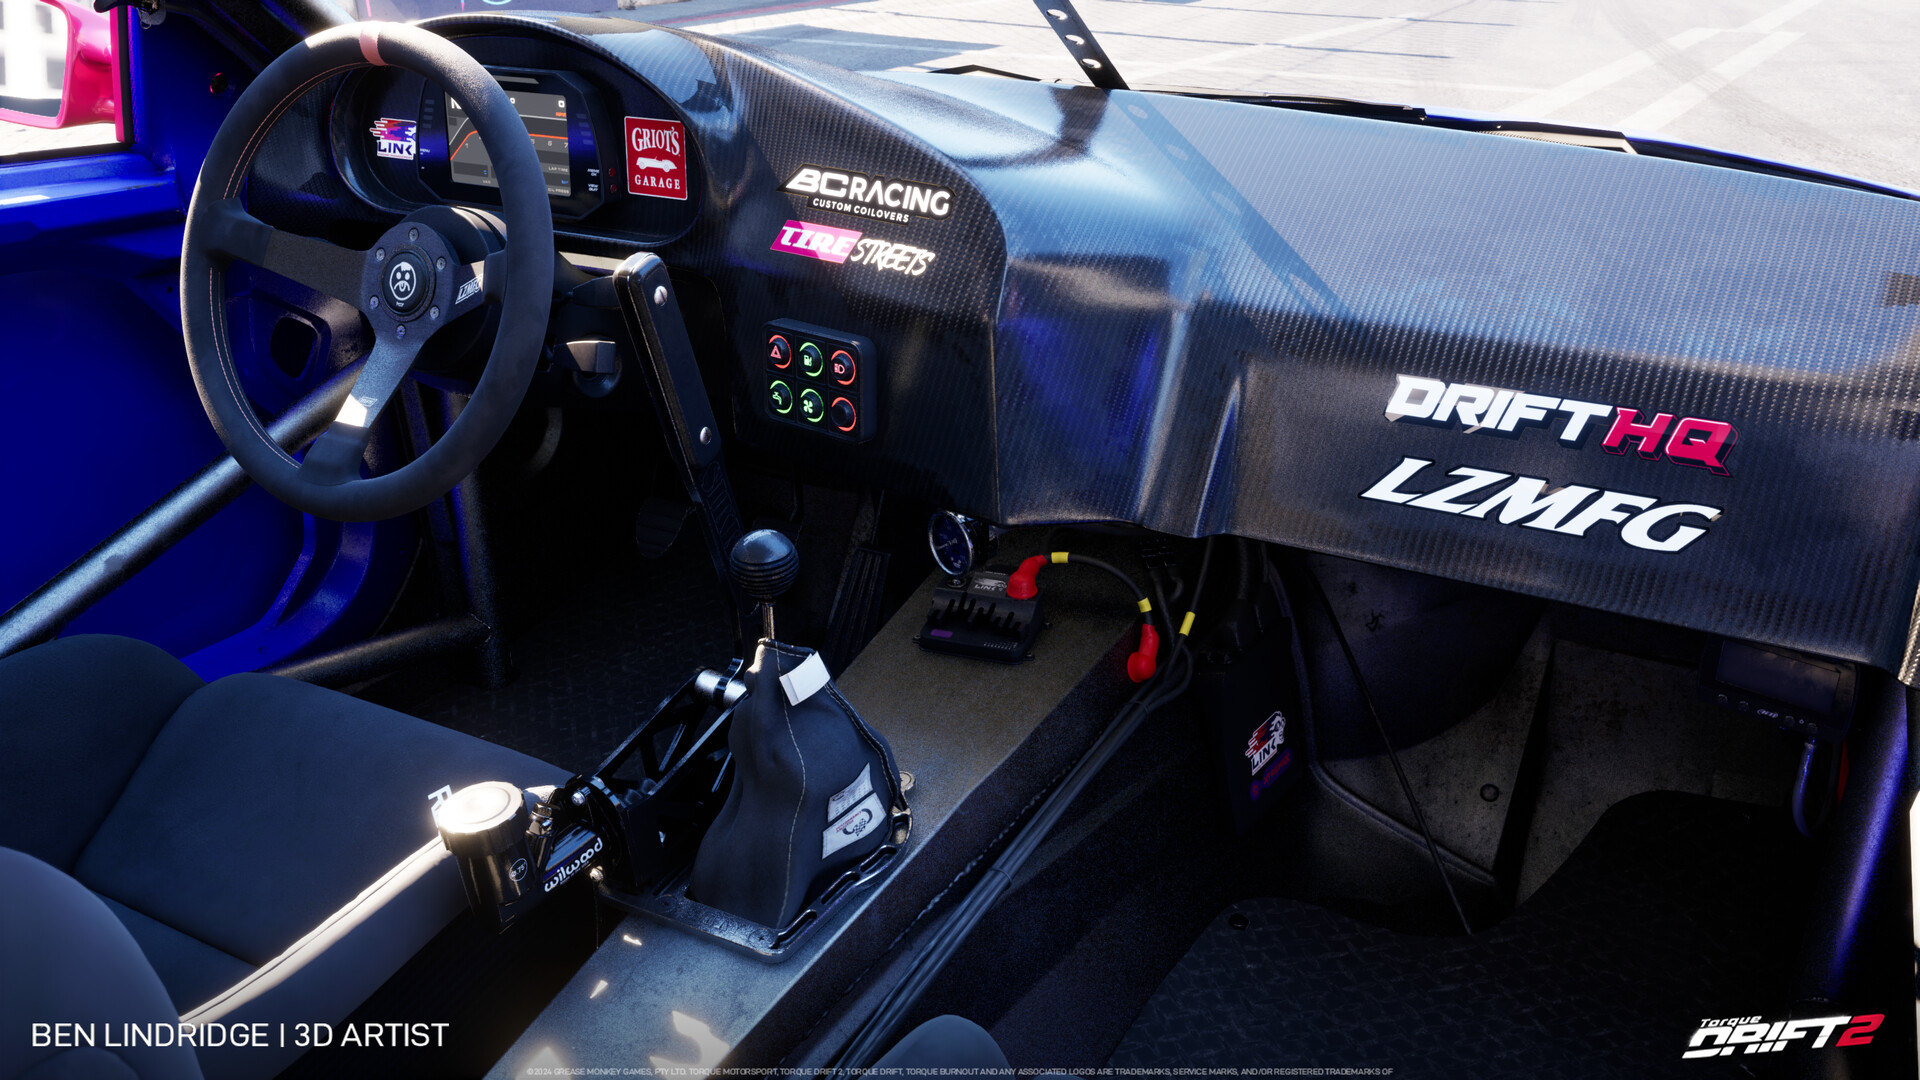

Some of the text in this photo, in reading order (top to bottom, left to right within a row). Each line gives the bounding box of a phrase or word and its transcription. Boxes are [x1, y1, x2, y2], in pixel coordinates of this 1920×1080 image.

[377, 141, 413, 156] LINK
[632, 126, 680, 156] GRIOT'S
[634, 174, 681, 190] GARAGE
[812, 197, 910, 223] CUSTOM COILOVERS
[779, 225, 936, 276] TIRE STREETS
[1360, 456, 1724, 553] LZMFG
[544, 837, 603, 893] wilwood
